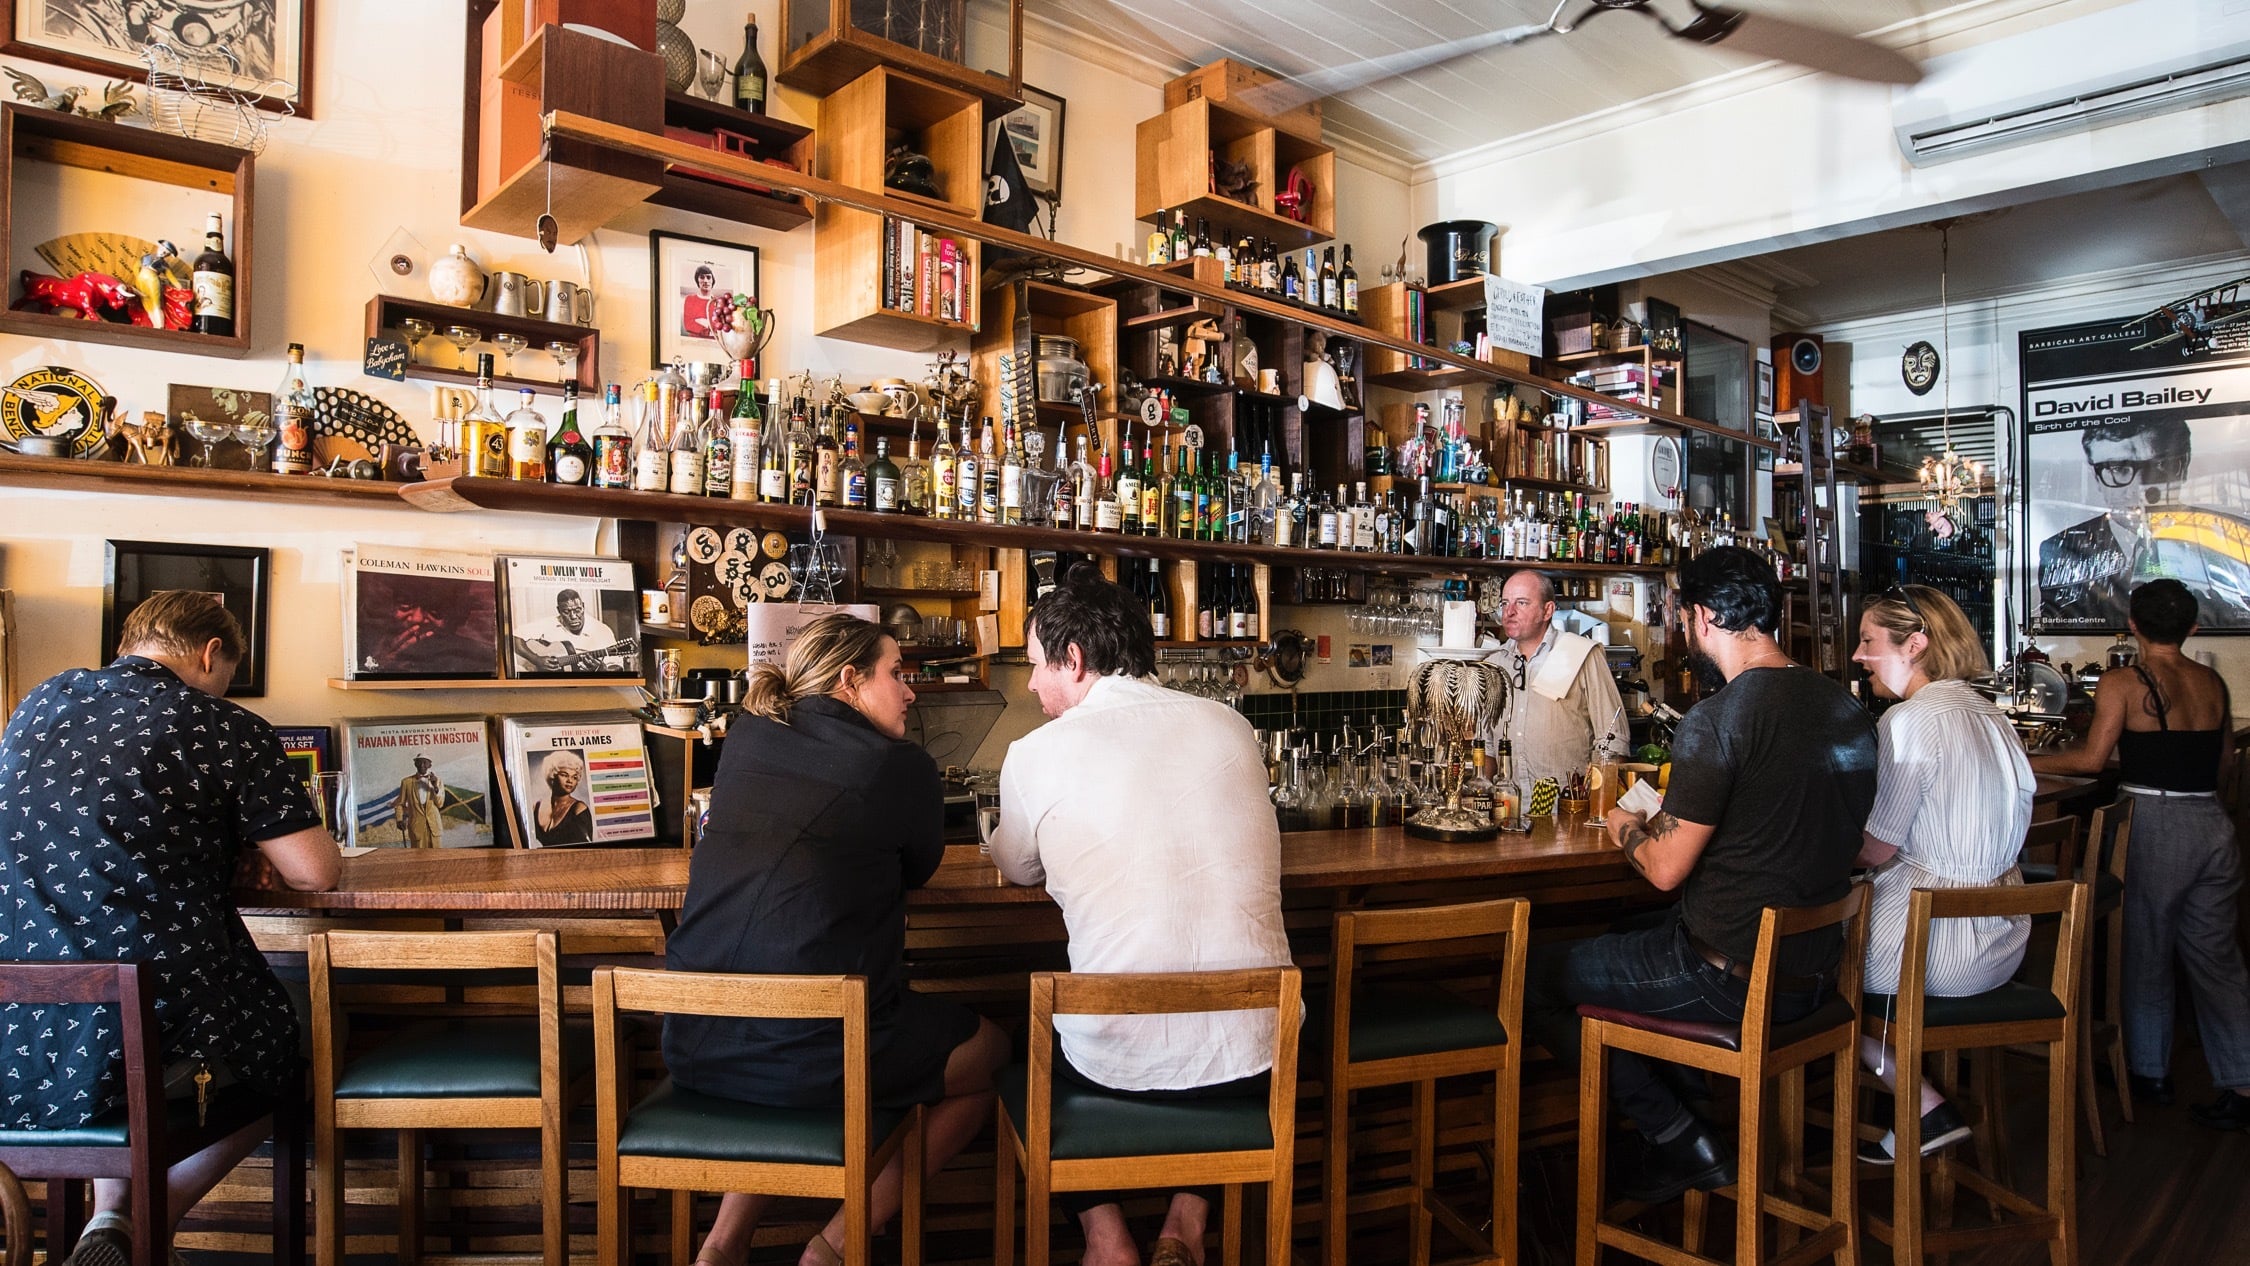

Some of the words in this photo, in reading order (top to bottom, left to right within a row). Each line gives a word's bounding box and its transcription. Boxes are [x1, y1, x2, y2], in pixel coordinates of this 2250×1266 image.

[2029, 338, 2075, 349] BARBICAN
[2079, 335, 2096, 343] ART
[2100, 329, 2142, 340] GALLERY
[370, 343, 388, 357] Love
[366, 353, 405, 370] Babycham
[17, 373, 96, 400] NATIONAL
[2035, 393, 2114, 417] David
[2121, 387, 2212, 408] Bailey
[2035, 421, 2062, 432] Birth
[2066, 420, 2077, 429] of
[2082, 418, 2100, 427] the
[2104, 415, 2130, 425] Cool
[491, 438, 504, 450] 43
[360, 558, 410, 570] COLEMAN
[416, 563, 465, 575] HAWKINS
[467, 567, 492, 577] SOUL
[540, 565, 578, 577] HOWLIN'
[579, 566, 603, 578] WOLF
[2042, 616, 2077, 624] Barbican
[2079, 616, 2106, 624] Centre
[297, 741, 314, 749] SET
[357, 735, 397, 749] HAVANA
[399, 734, 431, 747] MEETS
[433, 732, 479, 744] KINGSTON
[552, 737, 576, 747] ETTA
[579, 735, 612, 746] JAMES
